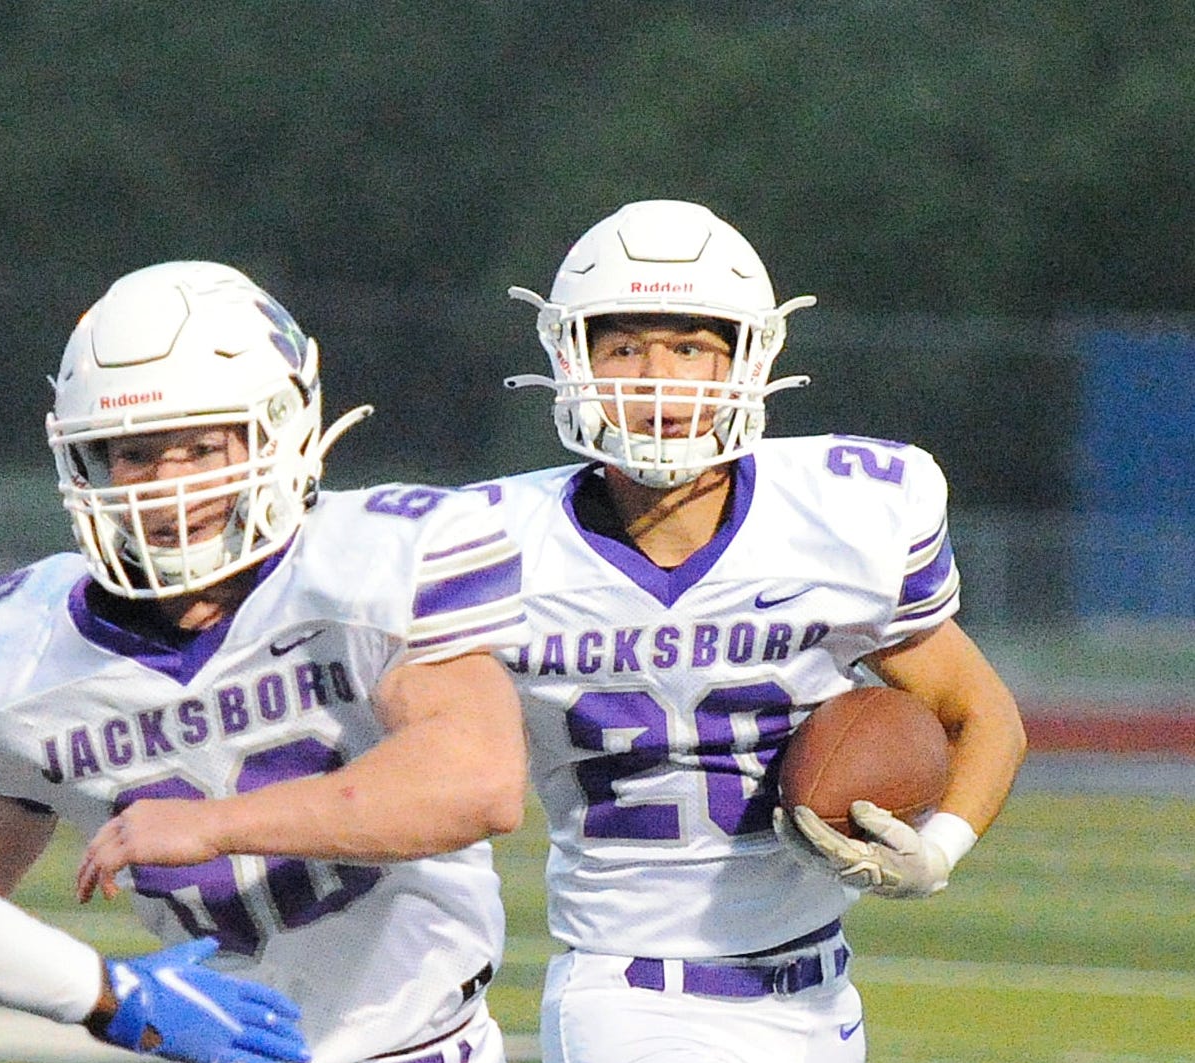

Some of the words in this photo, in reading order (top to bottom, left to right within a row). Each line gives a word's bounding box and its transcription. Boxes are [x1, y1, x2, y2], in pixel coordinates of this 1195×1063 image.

[630, 281, 693, 294] Riddell
[39, 660, 356, 785] JACKSBORO
[563, 676, 796, 843] 20
